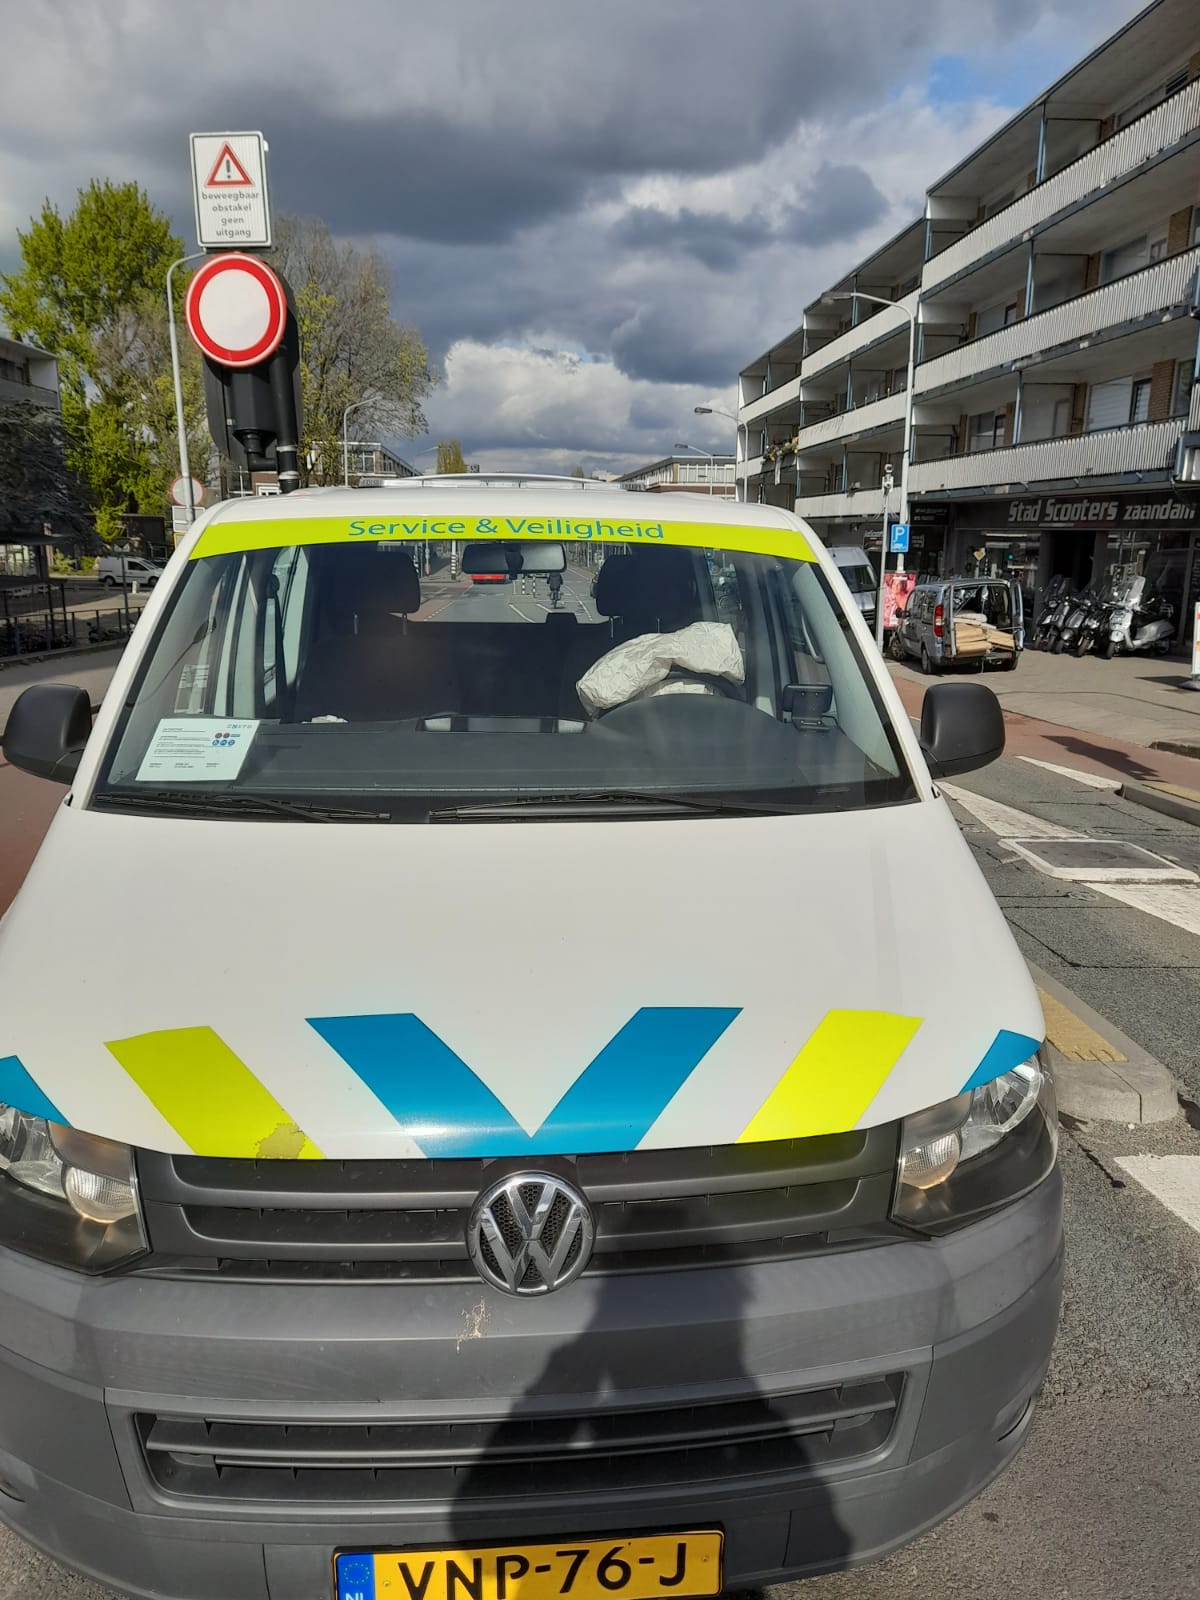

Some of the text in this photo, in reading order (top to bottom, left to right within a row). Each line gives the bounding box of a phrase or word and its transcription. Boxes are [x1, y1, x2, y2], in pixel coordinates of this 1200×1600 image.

[201, 191, 259, 201] beweegbaar
[212, 203, 252, 212] obstakel
[221, 216, 245, 226] geen
[215, 228, 252, 239] uitgang
[1008, 499, 1042, 522] Stad
[1044, 498, 1119, 521] Scooters
[348, 518, 665, 541] Service & Veiligheid
[894, 526, 905, 542] P
[397, 1541, 688, 1600] VNP-76-J
